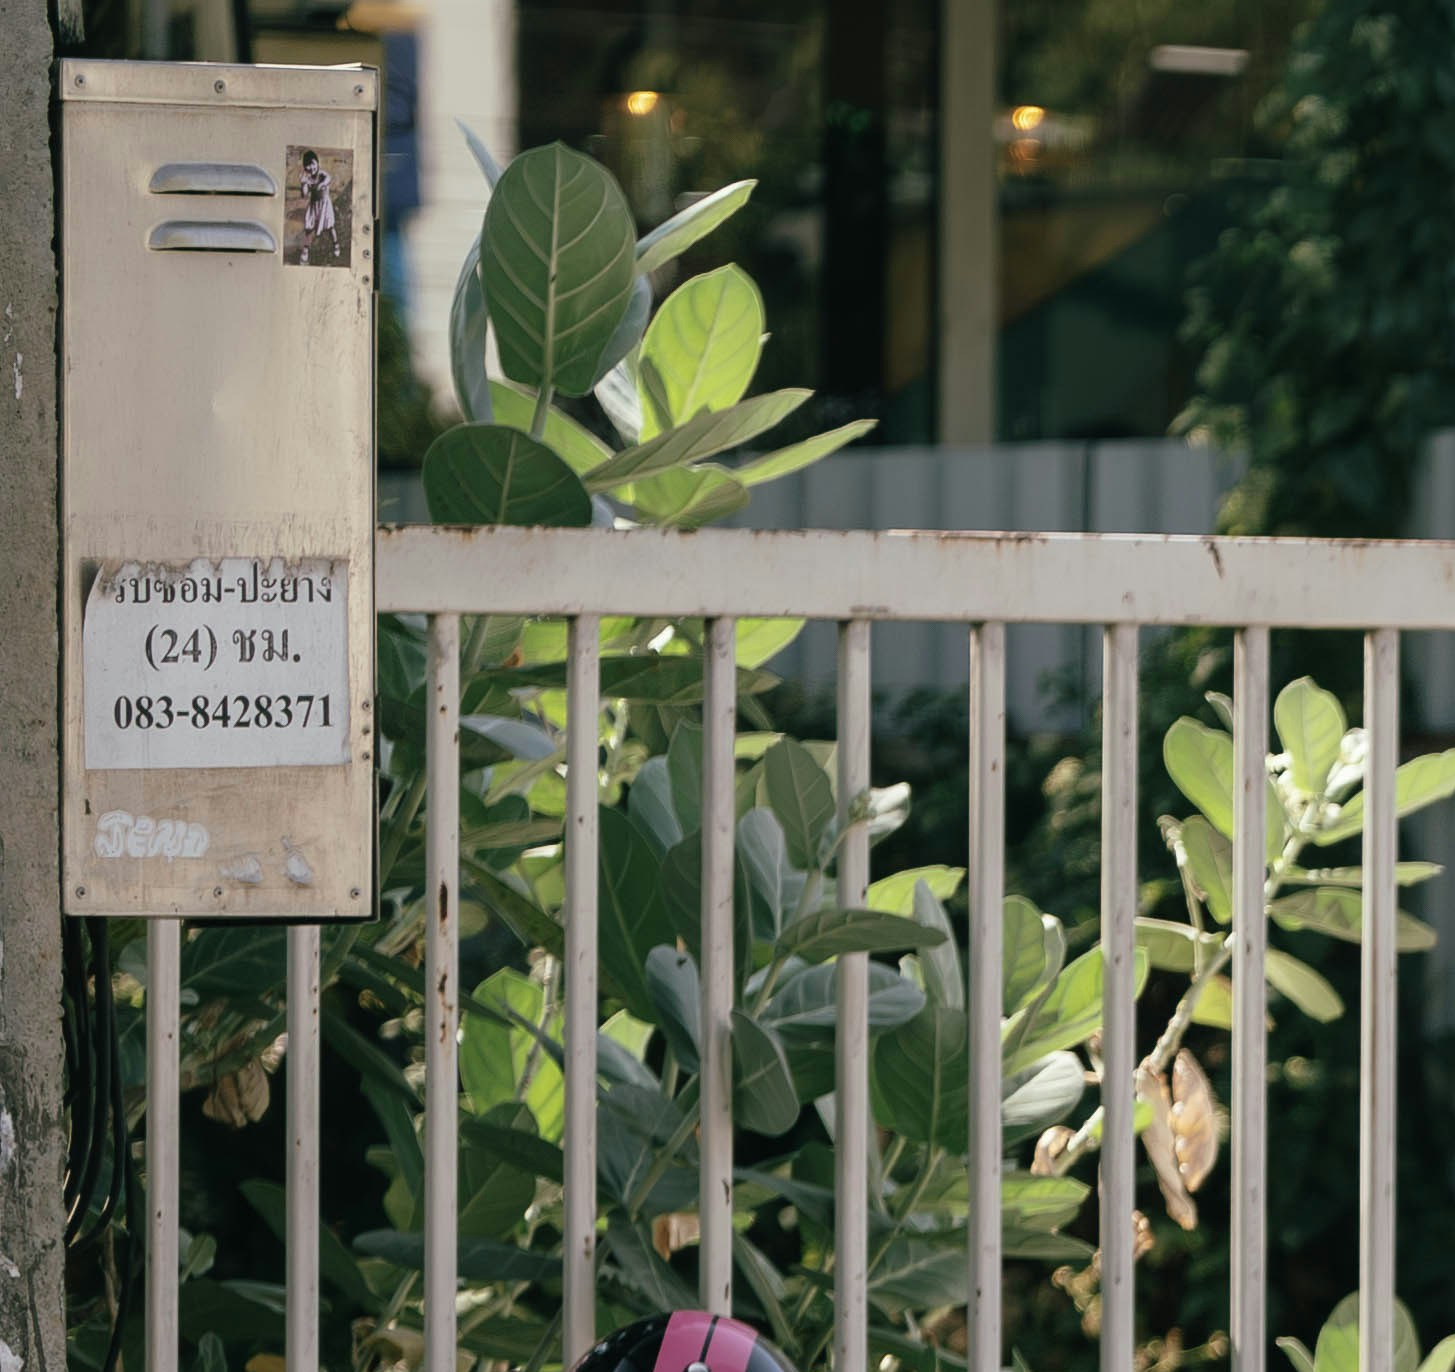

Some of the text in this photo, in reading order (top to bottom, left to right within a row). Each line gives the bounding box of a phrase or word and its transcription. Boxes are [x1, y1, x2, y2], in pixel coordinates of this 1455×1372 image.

[145, 624, 301, 671] (24) ชม.
[114, 694, 334, 729] 083-8428371
